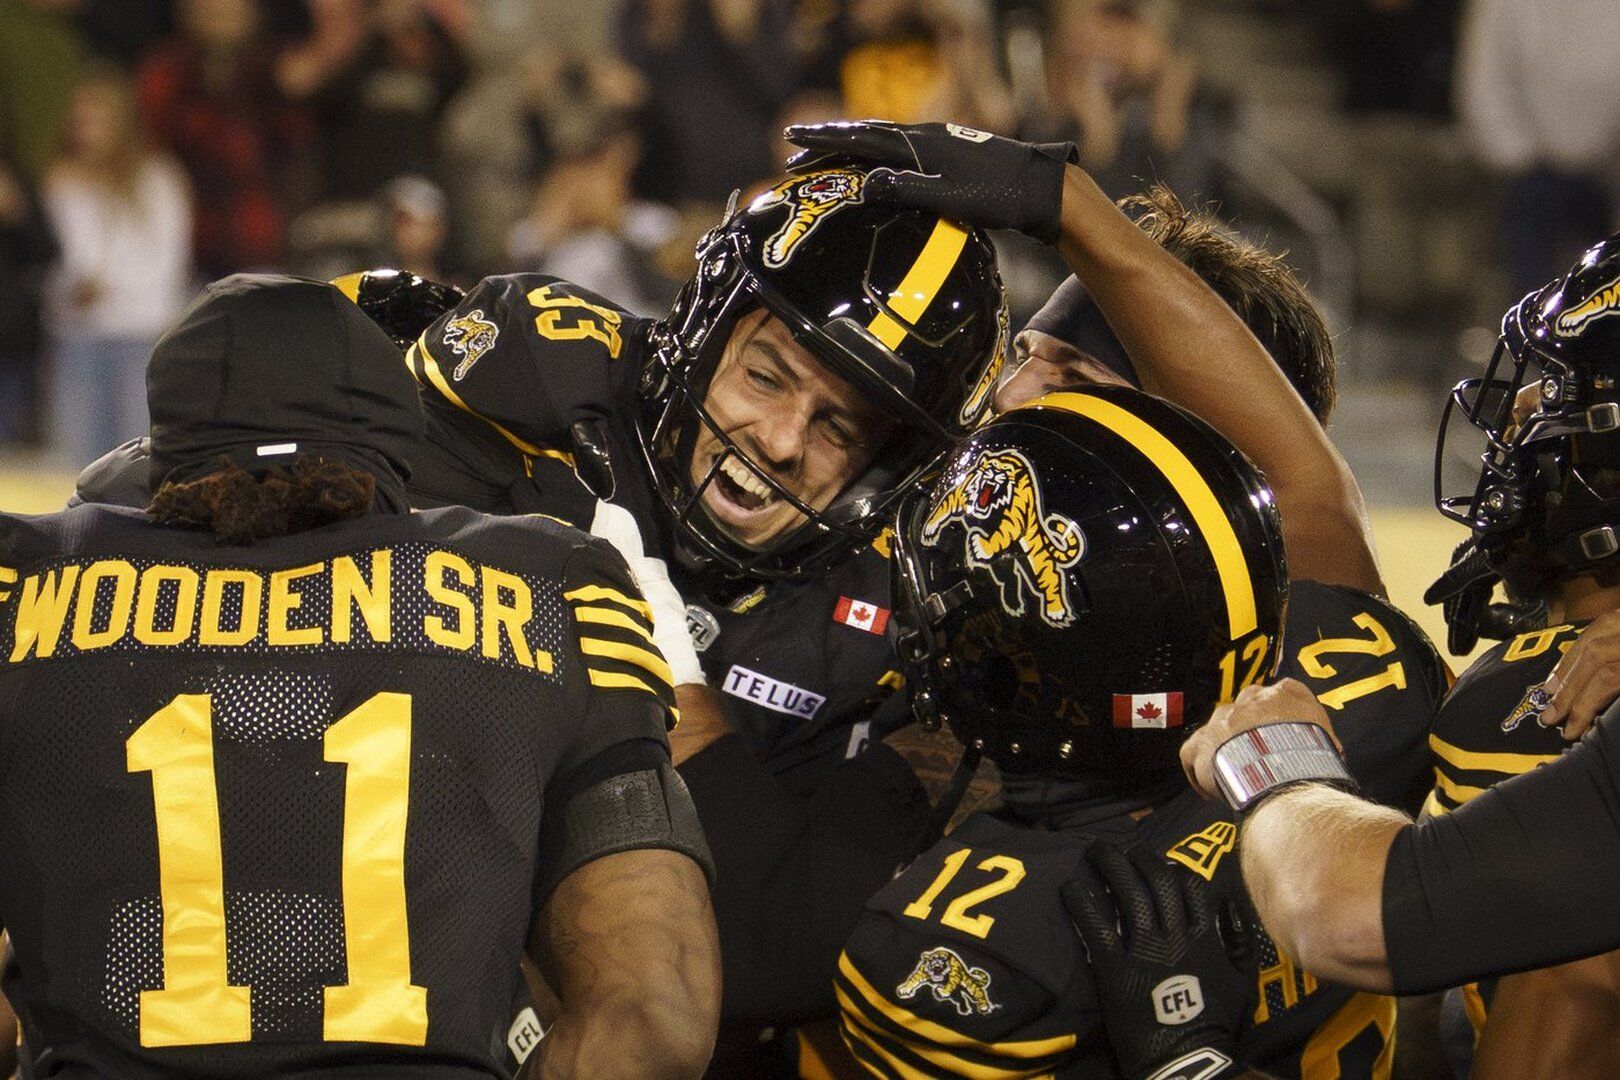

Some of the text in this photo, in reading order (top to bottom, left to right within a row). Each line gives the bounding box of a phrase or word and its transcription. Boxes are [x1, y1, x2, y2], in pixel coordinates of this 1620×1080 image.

[9, 548, 554, 675] WOODEN SR.
[731, 669, 819, 714] TELUS
[1216, 633, 1268, 707] 12
[125, 691, 429, 1049] 11
[902, 848, 1027, 940] 12
[514, 1021, 540, 1053] CFL
[1161, 988, 1197, 1015] CFL
